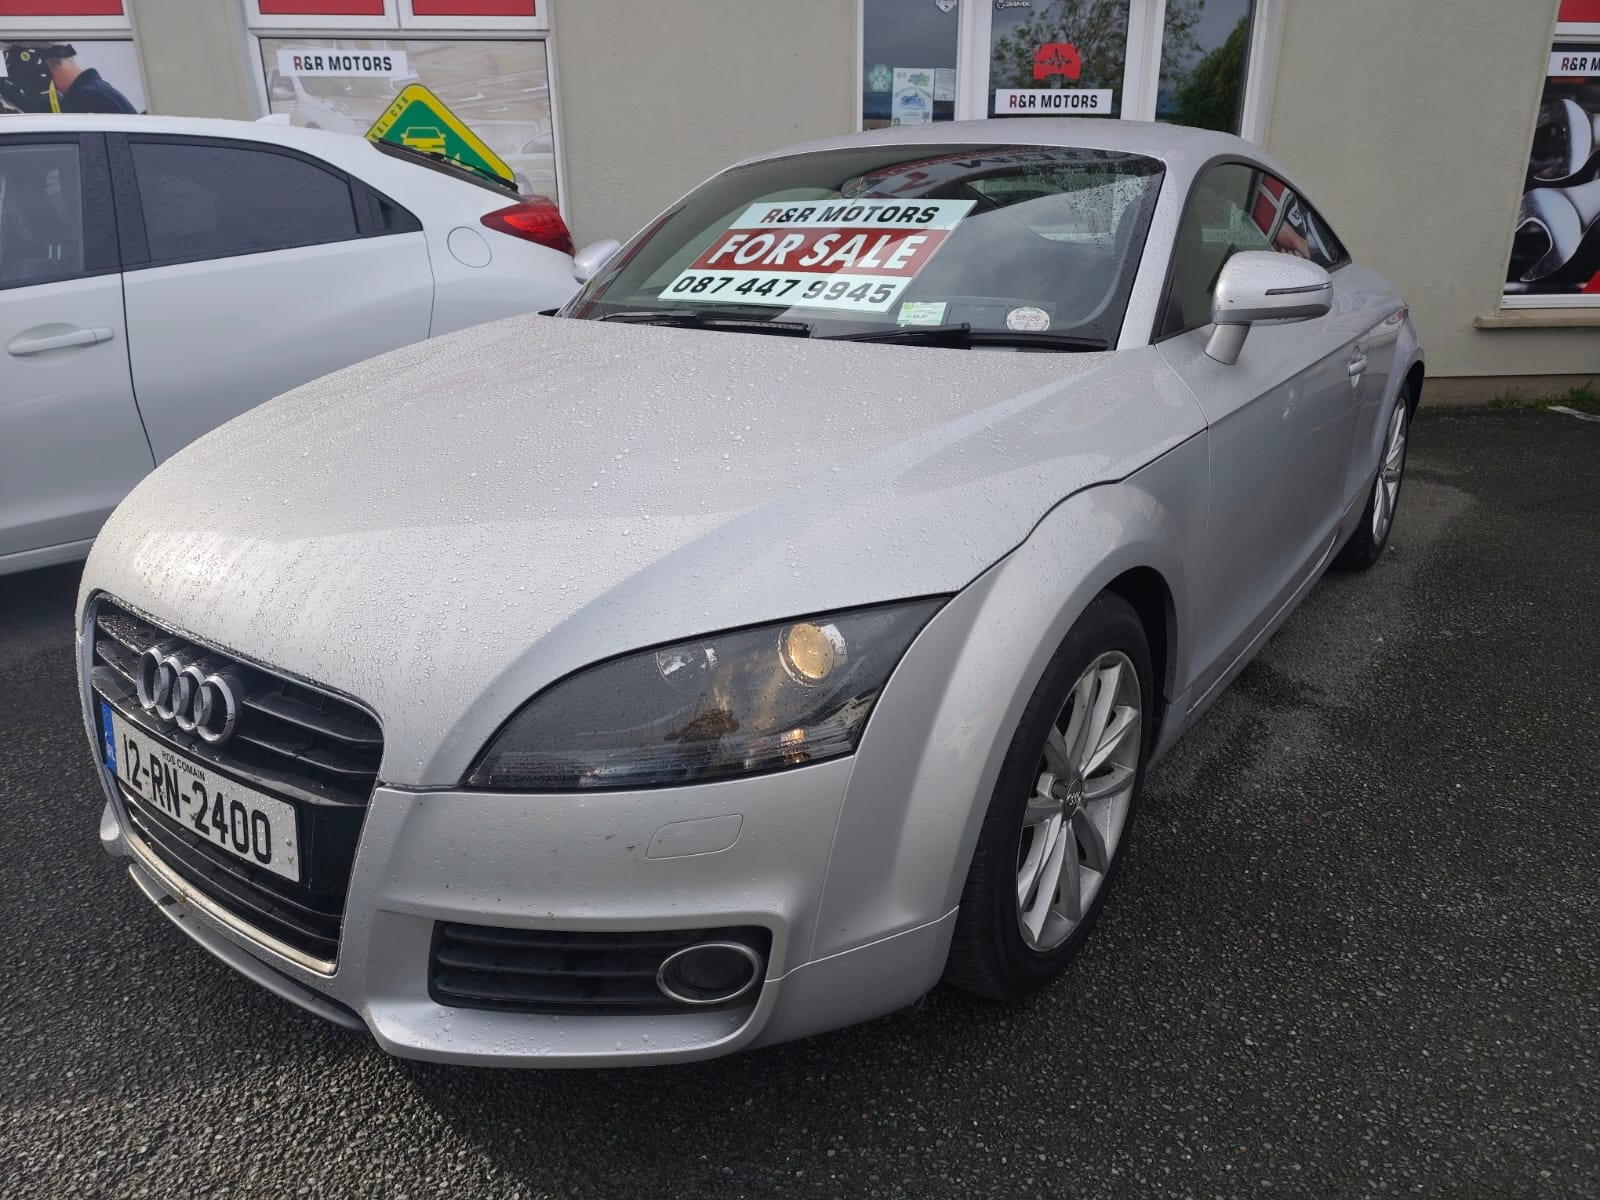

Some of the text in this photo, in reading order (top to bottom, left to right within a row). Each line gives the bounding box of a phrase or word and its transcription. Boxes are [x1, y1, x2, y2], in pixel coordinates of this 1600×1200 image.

[293, 56, 393, 71] R&R MOTORS
[1561, 57, 1587, 71] R&R
[1009, 95, 1098, 108] R&R MOTORS
[760, 206, 940, 224] R&R MOTORS
[707, 233, 929, 270] FOR SALE
[672, 276, 897, 304] 087 447 9945
[123, 733, 272, 865] 12-RN-2400
